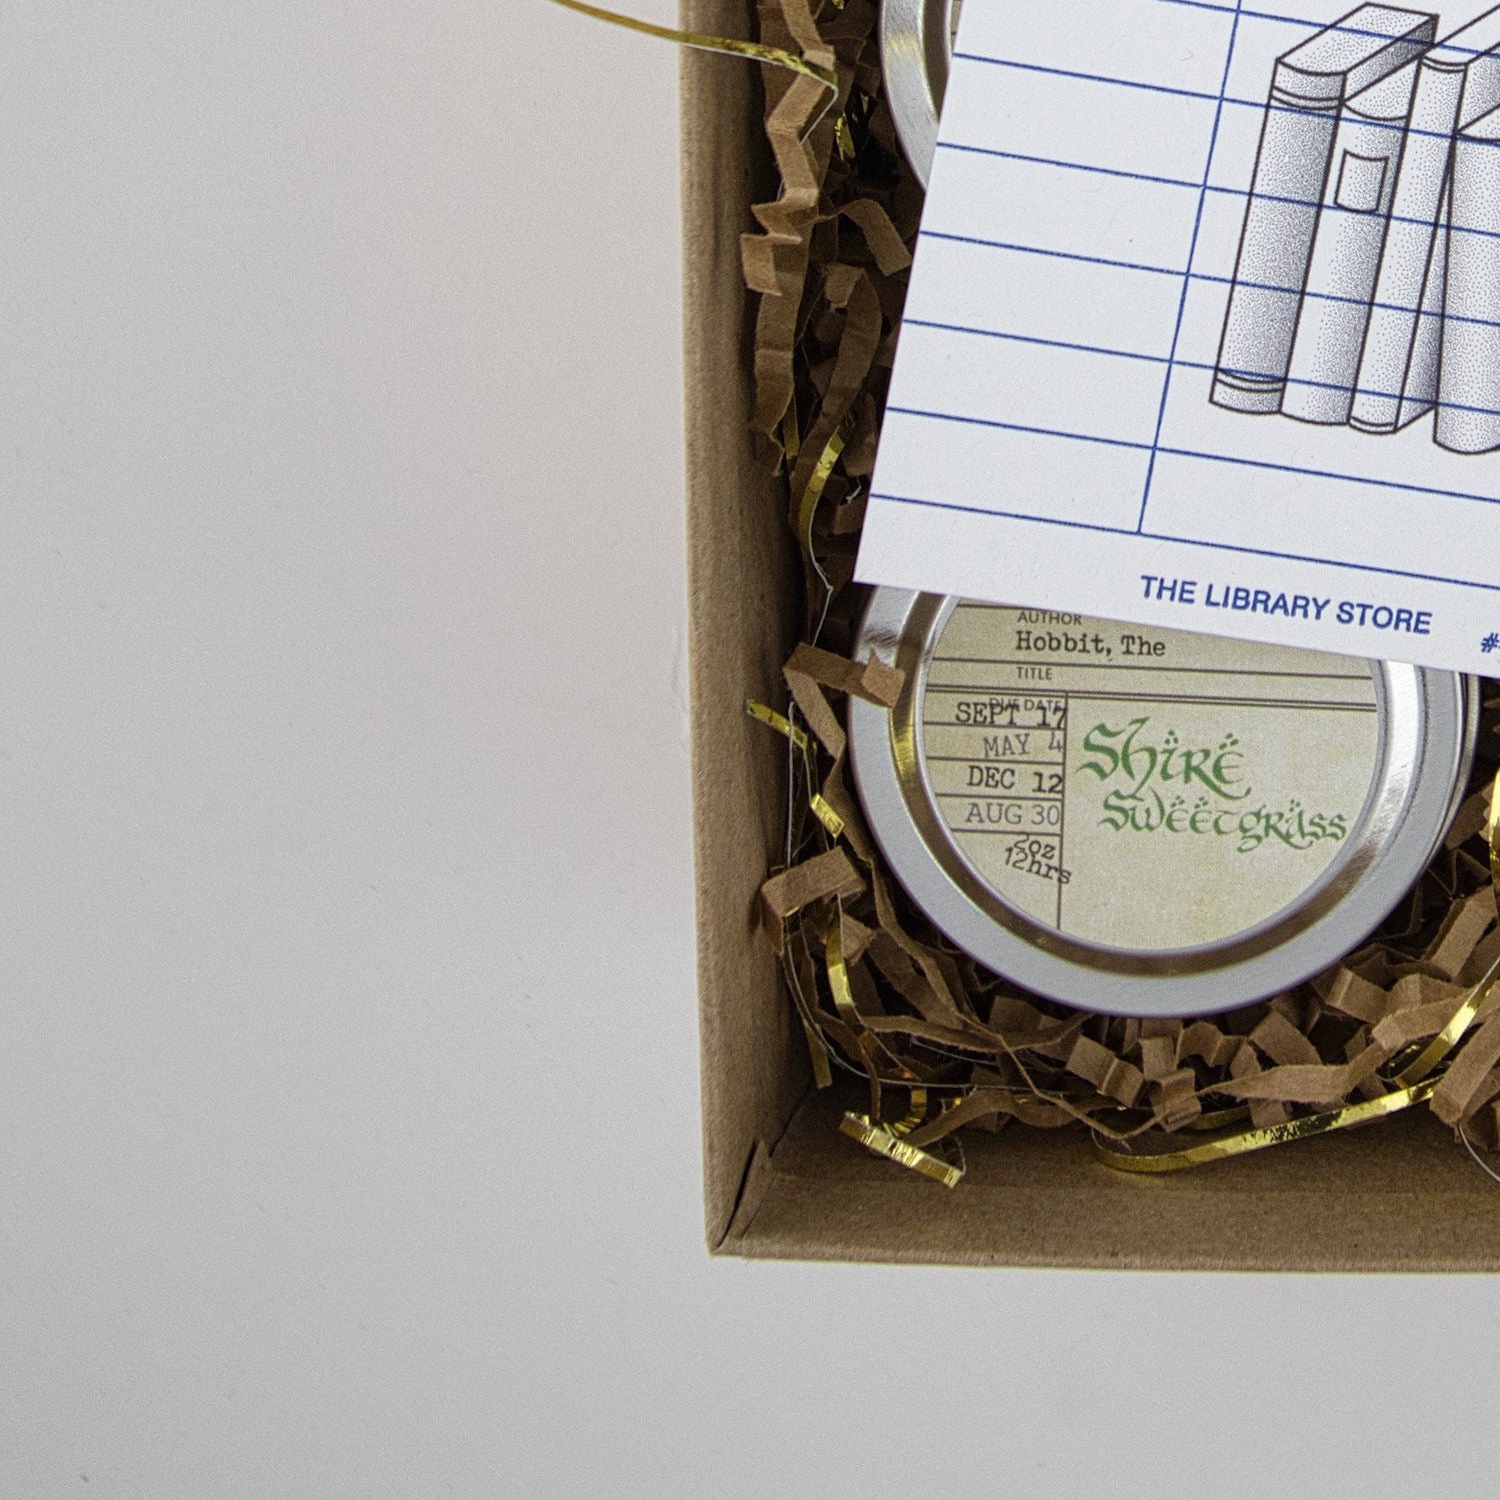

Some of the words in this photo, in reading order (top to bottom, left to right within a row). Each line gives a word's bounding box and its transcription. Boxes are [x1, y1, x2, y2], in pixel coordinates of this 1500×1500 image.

[1018, 610, 1082, 626] AUTHOR
[1140, 575, 1198, 605] THE
[1204, 583, 1331, 622] LIBRARY
[1337, 601, 1433, 635] STORE
[1015, 630, 1113, 657] Hobbit,
[1120, 634, 1167, 657] The
[1016, 666, 1053, 680] TITLE
[955, 702, 1021, 727] SEPT
[1036, 705, 1068, 730] 17
[982, 733, 1031, 758] MAY
[1047, 731, 1064, 753] 4
[966, 764, 1016, 790] DEC
[1031, 771, 1064, 795] 12
[964, 802, 1023, 825] AUG
[1030, 803, 1061, 827] 30
[1013, 832, 1057, 861] 2oz
[1004, 846, 1073, 885] 12hrs
